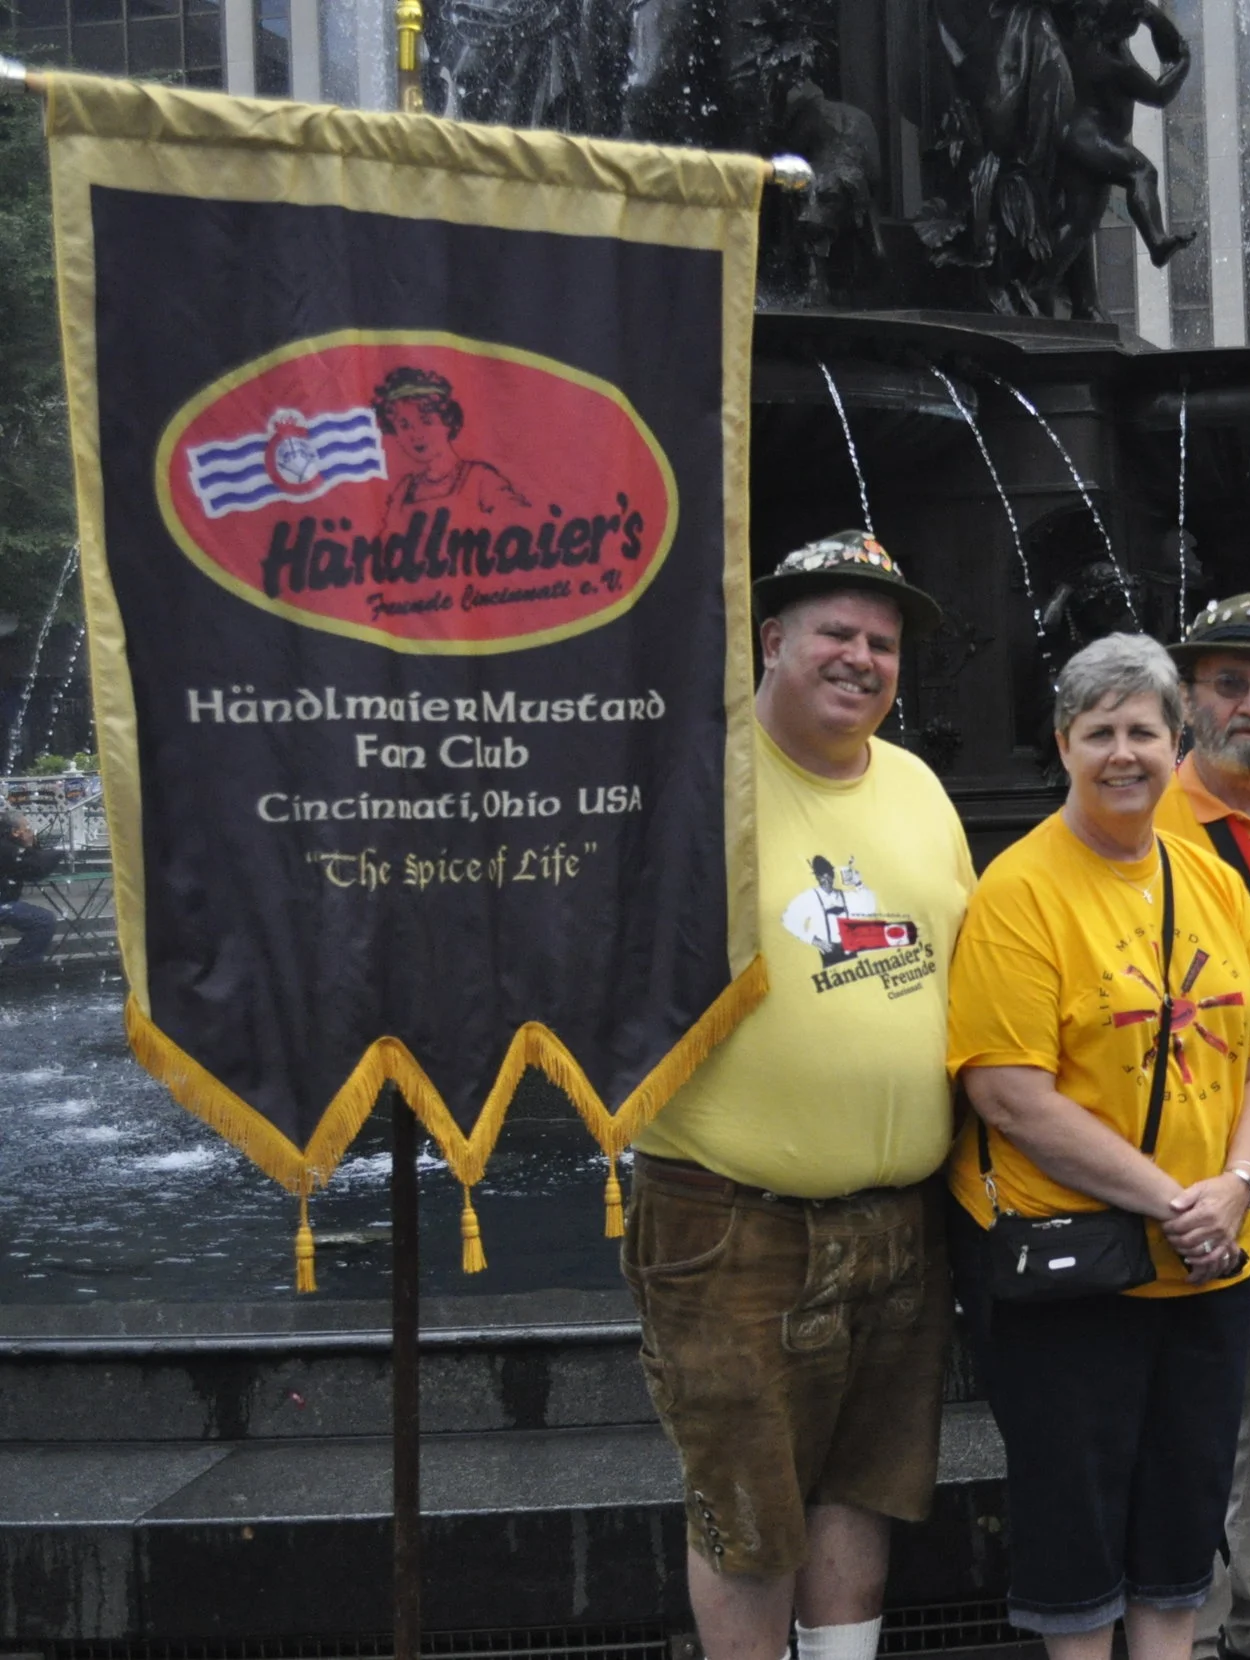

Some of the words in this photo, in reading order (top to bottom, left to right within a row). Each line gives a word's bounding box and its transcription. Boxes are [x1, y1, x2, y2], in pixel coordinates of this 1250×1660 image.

[262, 493, 643, 599] Händlmaier's
[356, 734, 426, 768] Fan
[439, 734, 529, 768] Club
[579, 785, 642, 814] USA
[404, 848, 481, 891] Spice
[488, 845, 508, 888] of
[811, 941, 934, 993] Händlmaier's
[880, 961, 936, 989] Freunde
